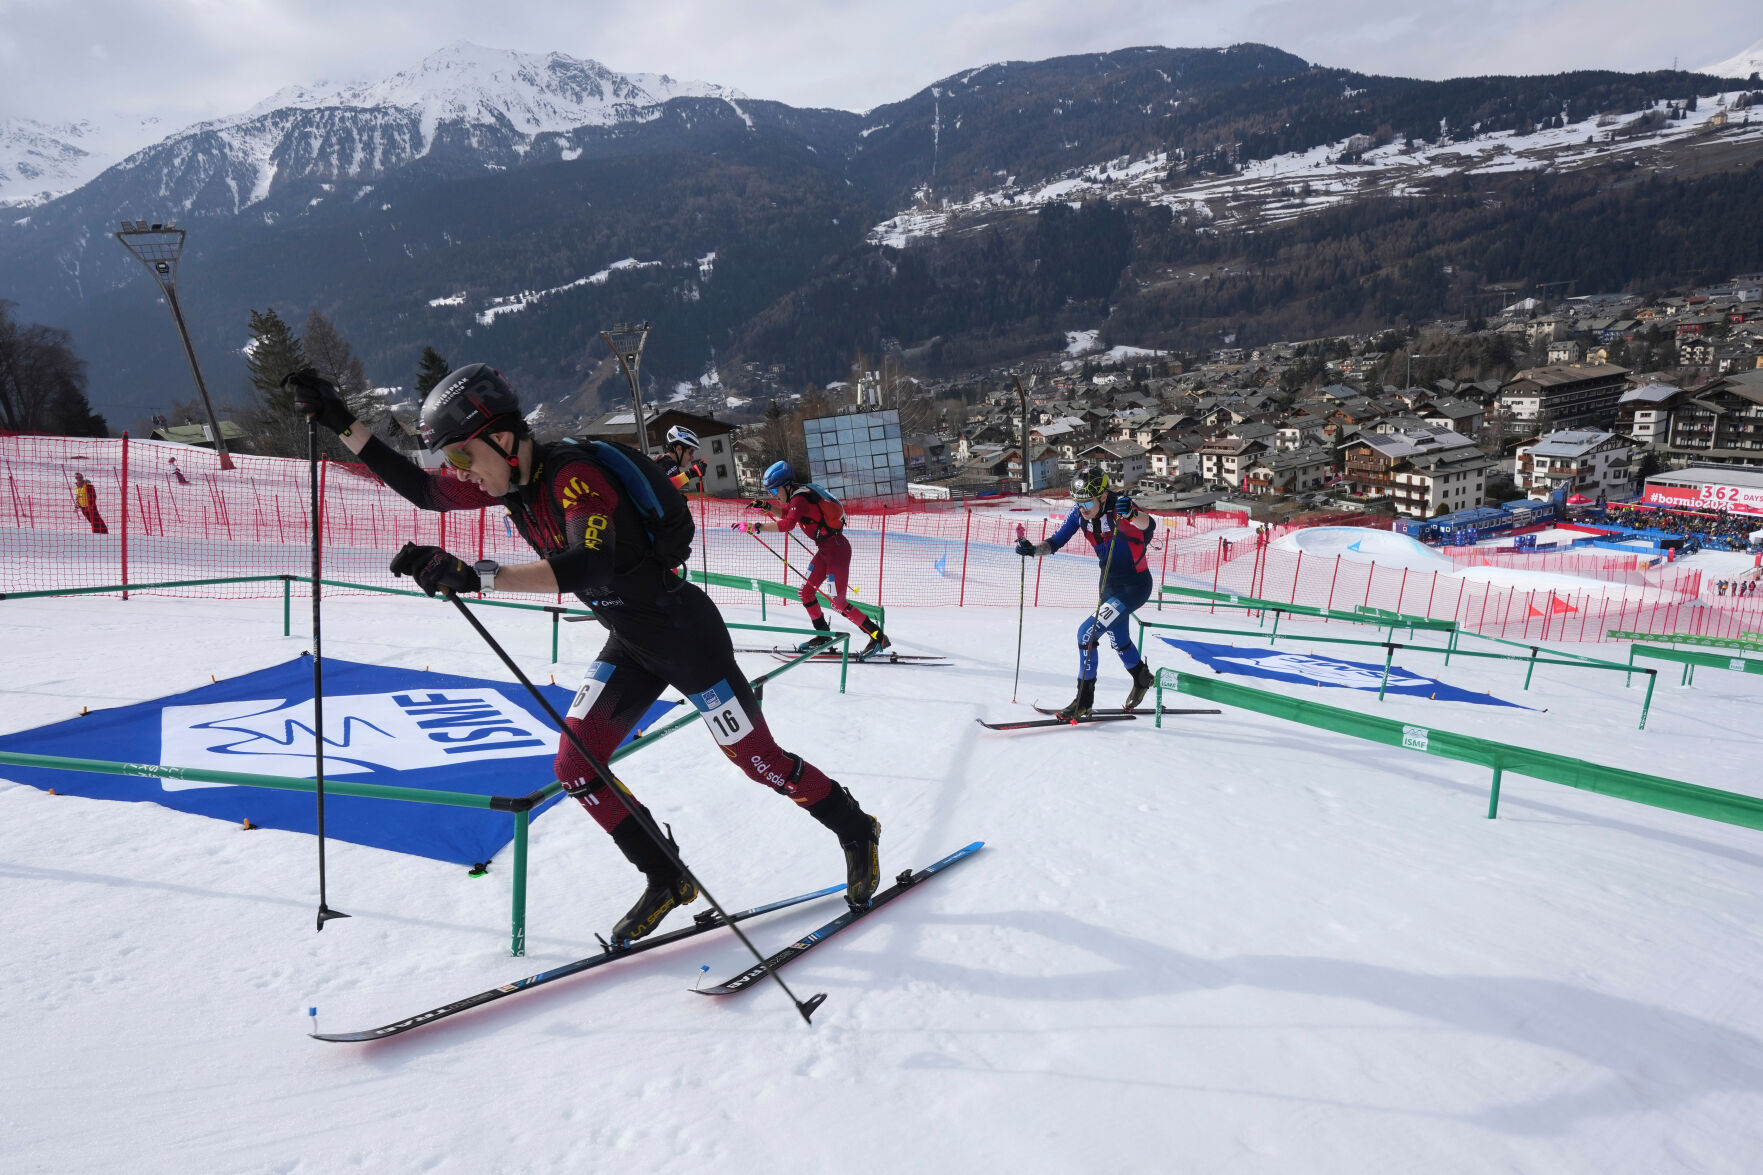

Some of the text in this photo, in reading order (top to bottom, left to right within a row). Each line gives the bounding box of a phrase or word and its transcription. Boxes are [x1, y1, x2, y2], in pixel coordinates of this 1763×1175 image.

[1099, 607, 1114, 620] 20
[573, 684, 590, 708] 6
[392, 694, 546, 754] ISMF
[713, 710, 740, 738] 16
[1404, 737, 1426, 748] ISMF
